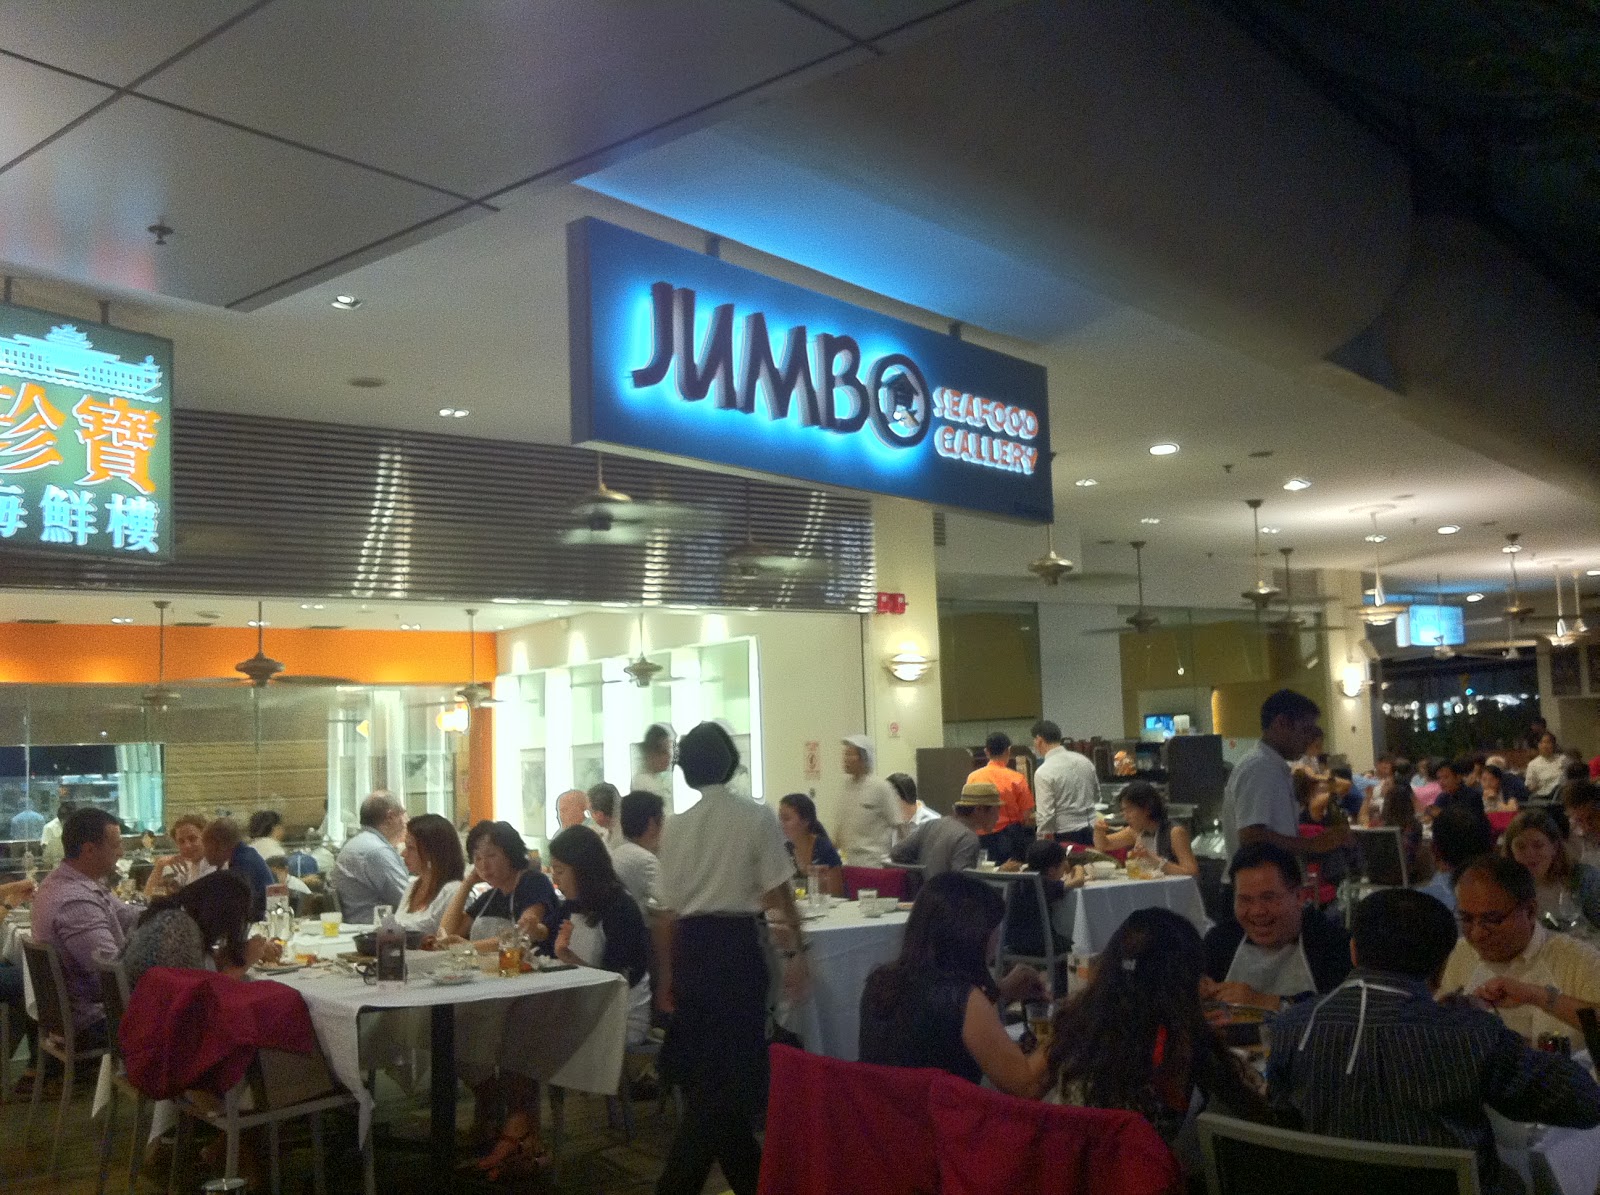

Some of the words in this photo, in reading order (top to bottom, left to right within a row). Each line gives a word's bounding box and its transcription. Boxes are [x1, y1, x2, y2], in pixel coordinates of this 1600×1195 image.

[630, 281, 931, 449] JUMBO
[0, 382, 162, 494] 珍寶
[933, 386, 1039, 440] SEAFOOD
[934, 425, 1038, 475] GALLERY
